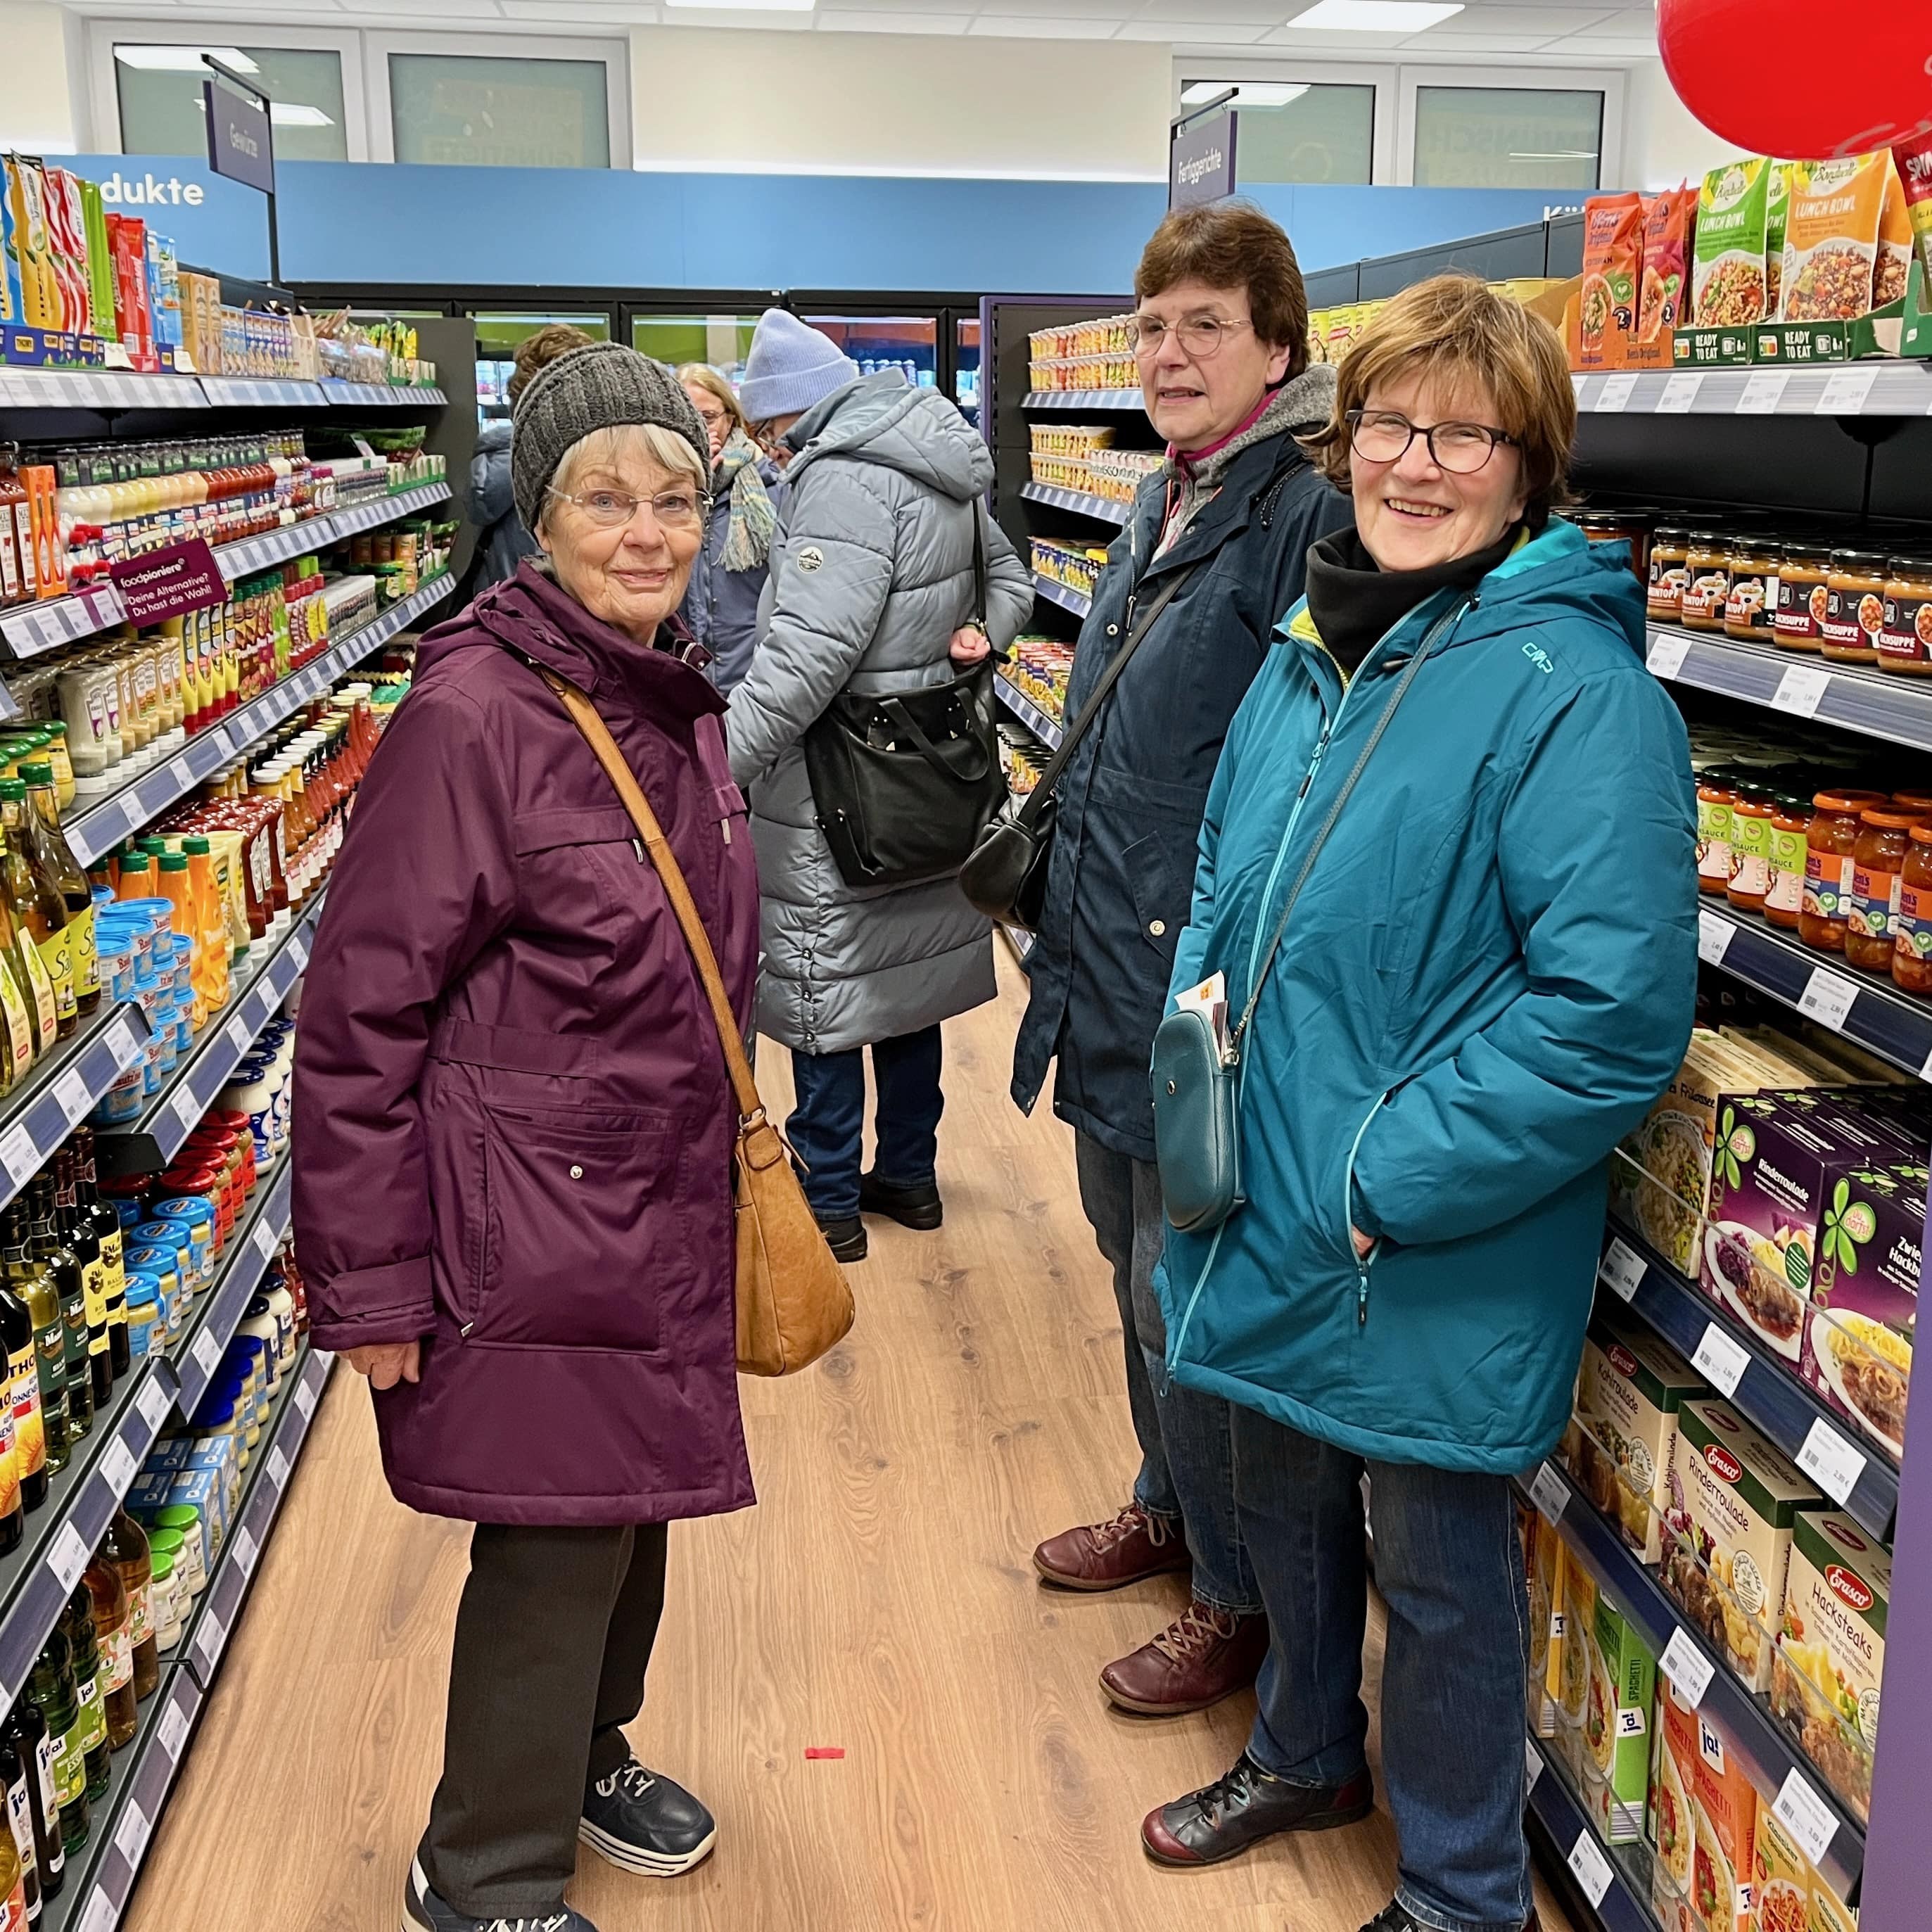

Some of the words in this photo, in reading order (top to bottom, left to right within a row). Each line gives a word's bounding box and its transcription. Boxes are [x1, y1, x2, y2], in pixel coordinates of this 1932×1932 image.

[1178, 147, 1221, 184] Fertiggerichte
[100, 172, 203, 205] dukte
[1700, 215, 1724, 232] LUNCH
[1724, 212, 1745, 229] BOWL
[1795, 199, 1828, 217] LUNCH
[1829, 195, 1855, 212] BOWL
[1619, 312, 1625, 325] 2
[1665, 307, 1670, 320] 2
[1696, 334, 1717, 347] READY
[1696, 348, 1705, 360] TO
[1705, 347, 1718, 360] EAT
[1784, 331, 1810, 345] READY
[1785, 345, 1798, 359] TO
[1798, 345, 1812, 358] EAT
[127, 591, 155, 606] Deine
[157, 573, 209, 597] Alternative?
[132, 606, 146, 617] Du
[148, 599, 168, 612] hast
[169, 594, 184, 606] die
[184, 585, 212, 600] Wahl!
[1759, 1158, 1810, 1203] Rinderroulade
[1845, 1217, 1869, 1235] darfst
[1853, 1208, 1862, 1219] Du
[1598, 1359, 1639, 1414] Kohlroulade
[1708, 1447, 1739, 1479] Erasco
[1689, 1456, 1748, 1531] Rinderroulade
[1830, 1568, 1869, 1607] Erasco
[1812, 1582, 1872, 1660] Hacksteaks
[1629, 1659, 1641, 1701] SPAGHETTI
[1622, 1712, 1641, 1733] ja!
[1702, 1722, 1719, 1758] ja!
[1695, 1760, 1731, 1820] SPAGHETTI
